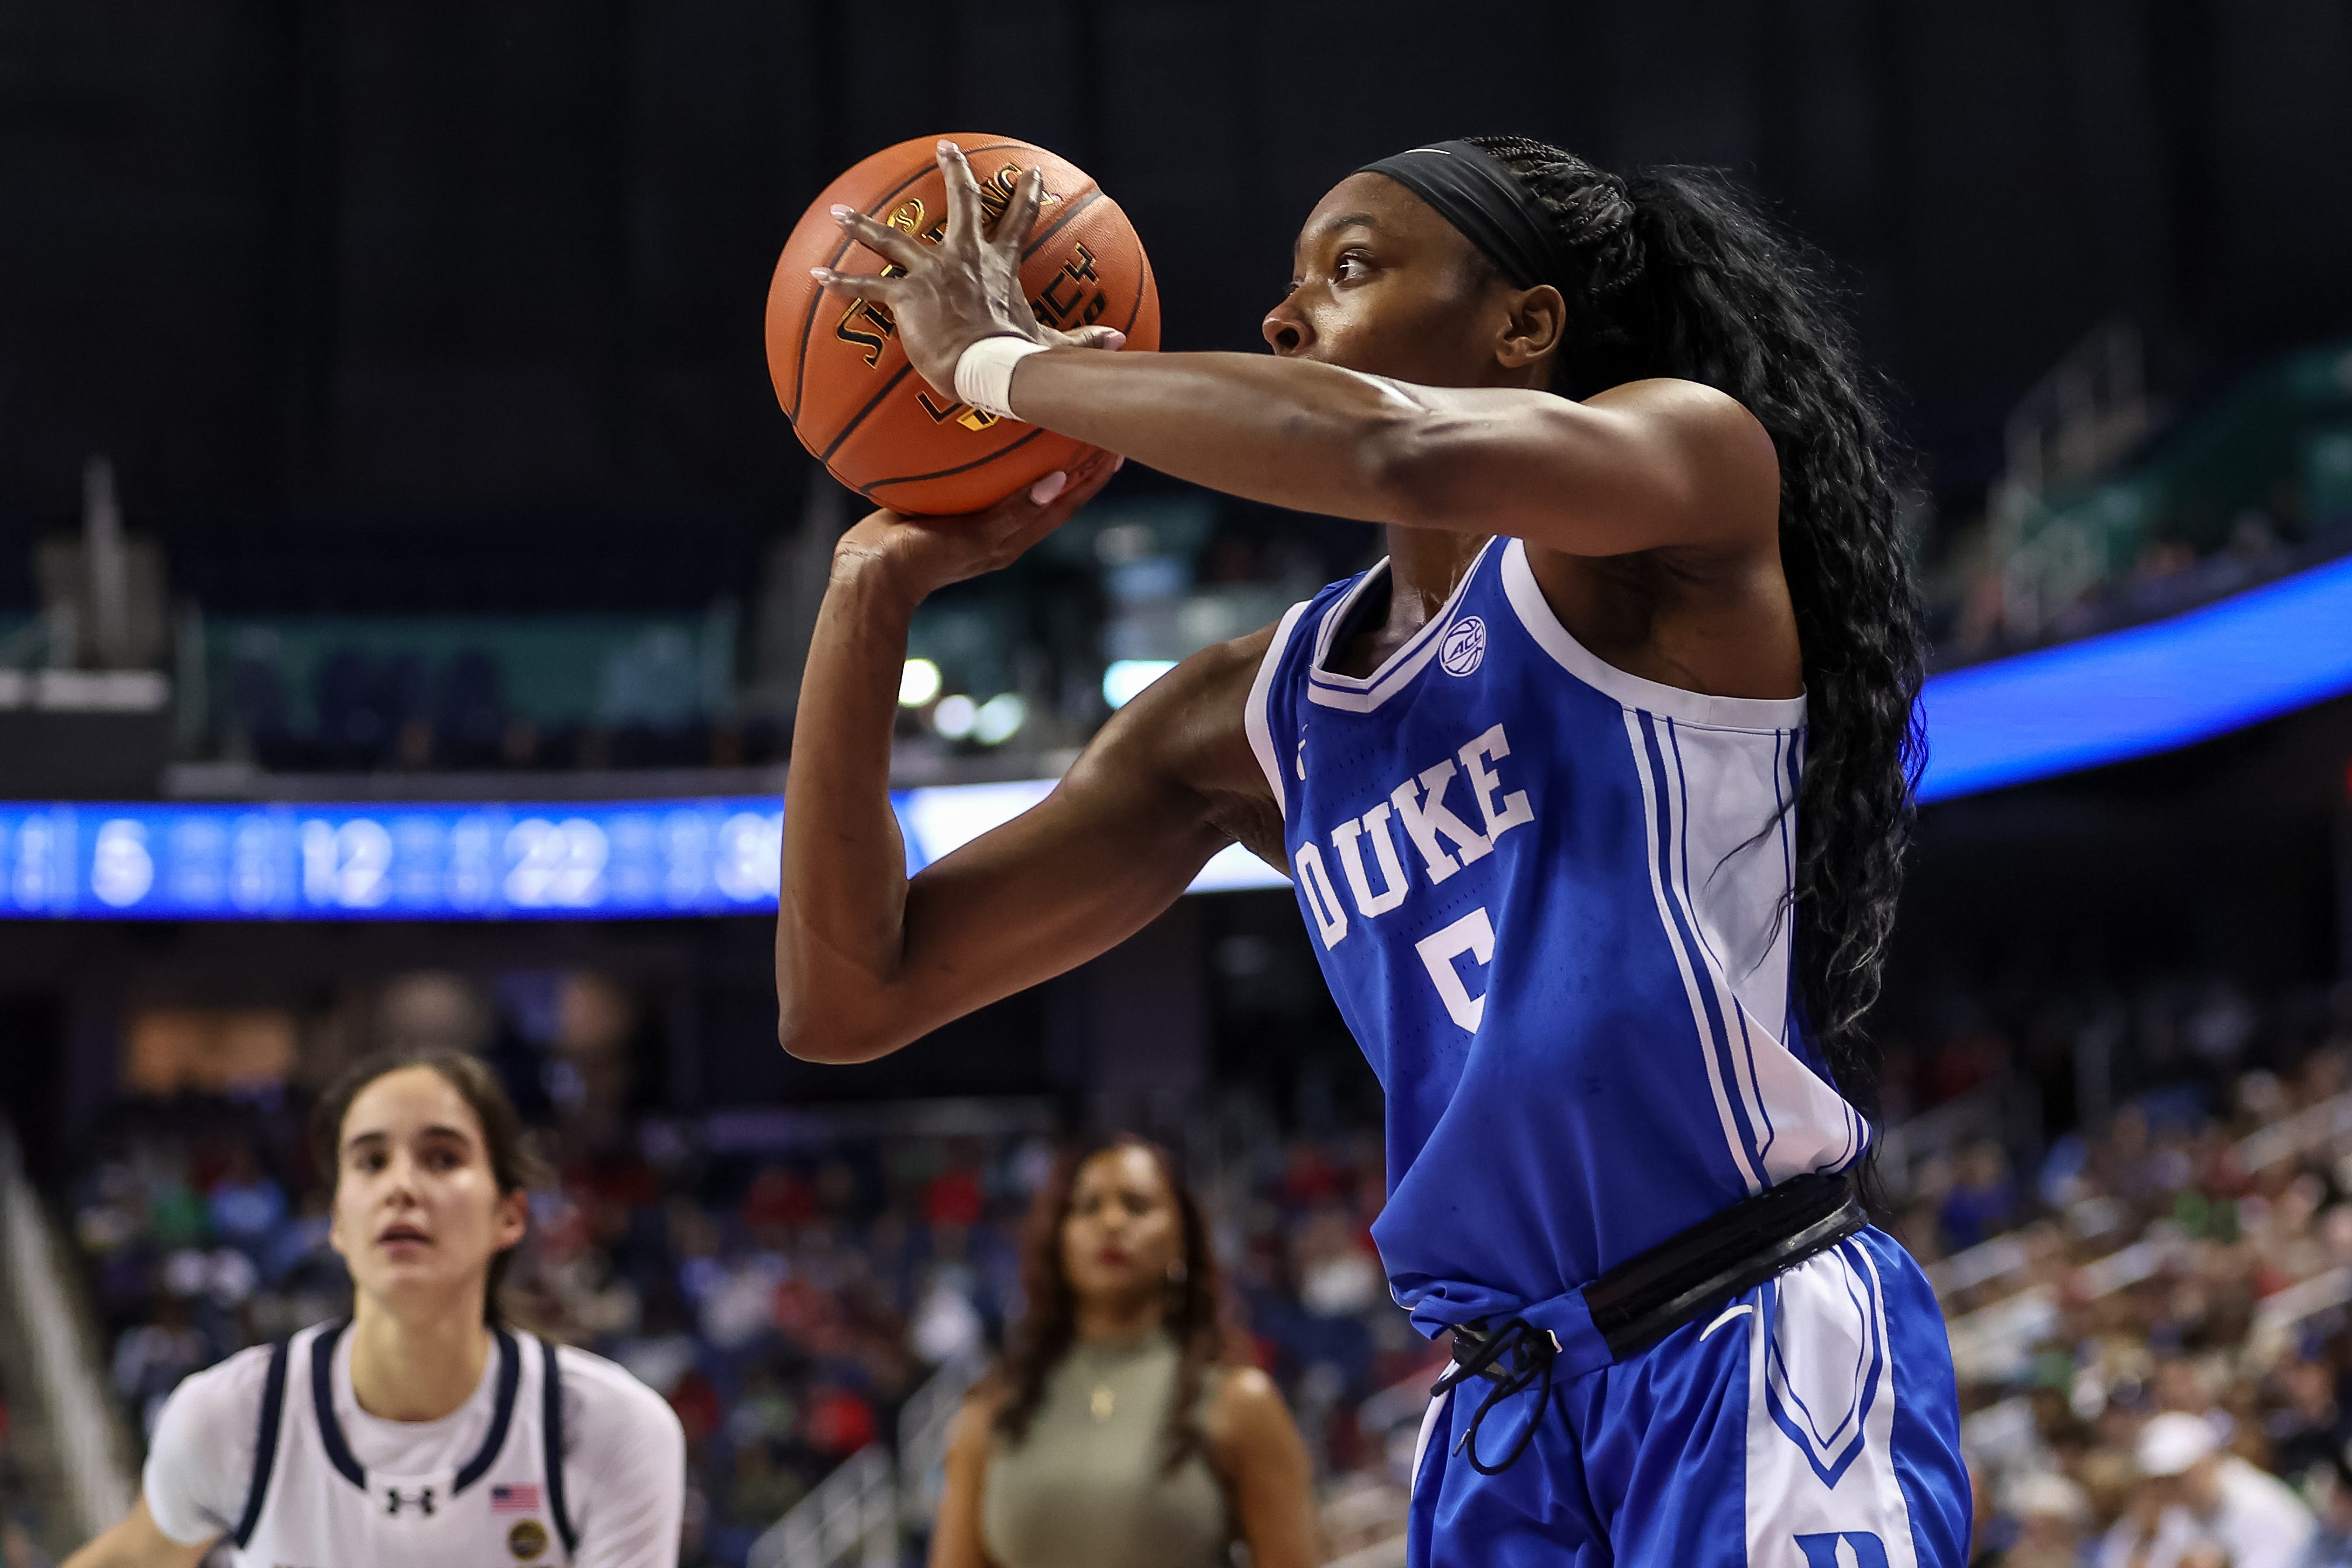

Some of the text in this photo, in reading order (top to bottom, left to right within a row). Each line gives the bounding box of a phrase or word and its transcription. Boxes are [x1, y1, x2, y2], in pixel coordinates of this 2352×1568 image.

[1448, 624, 1482, 661] ACC
[301, 818, 393, 909] 12
[503, 818, 609, 908] 22
[1295, 723, 1535, 951] DUKE
